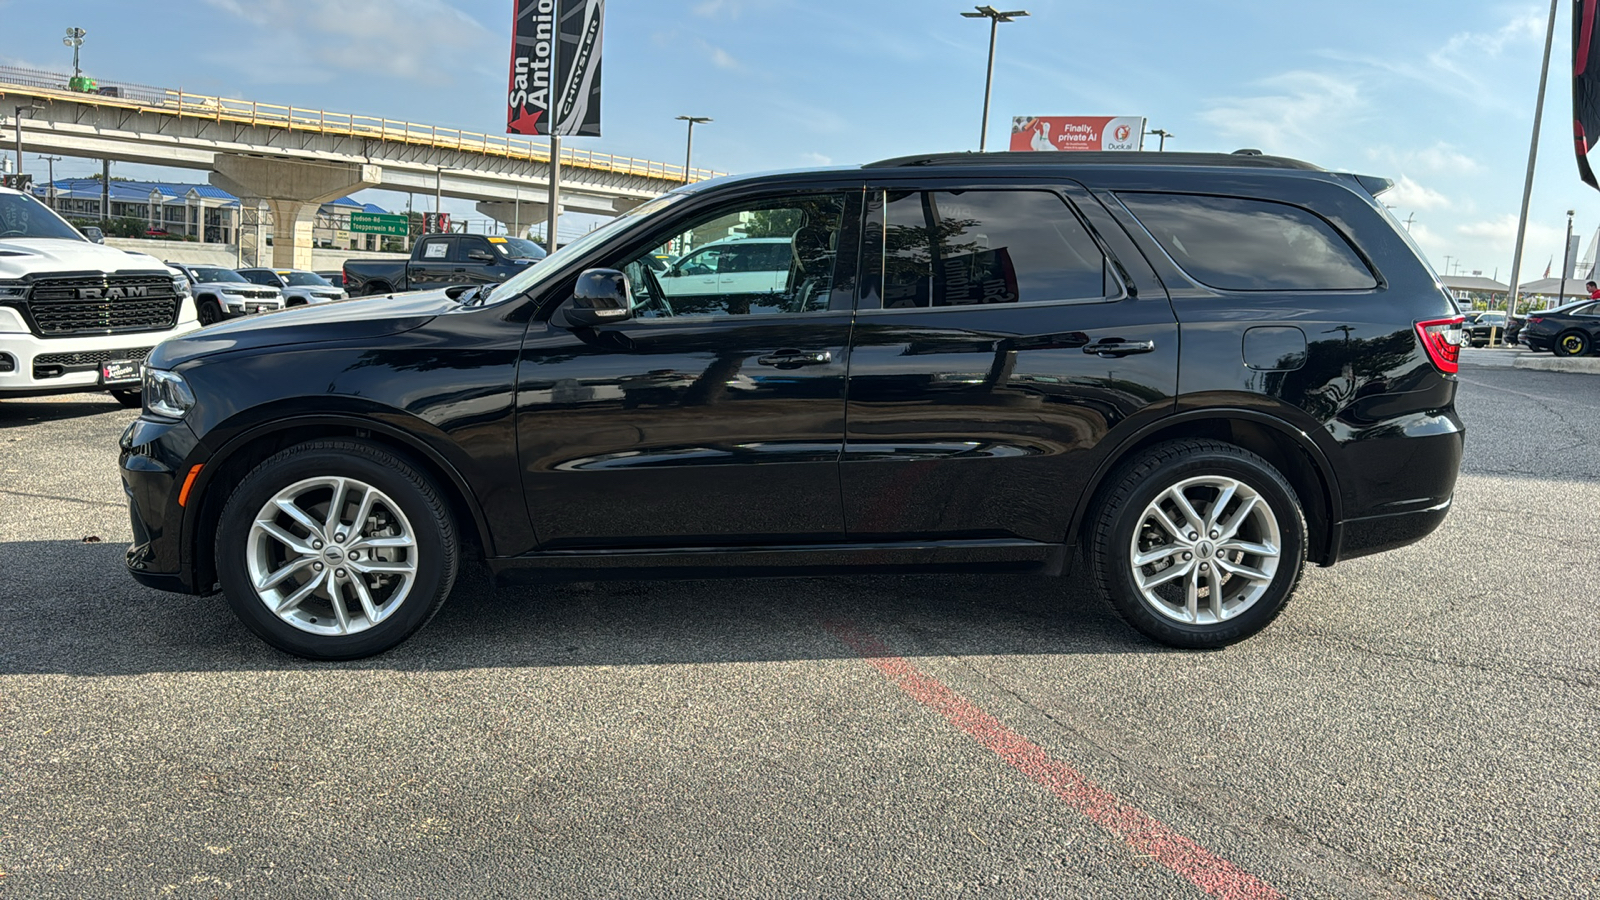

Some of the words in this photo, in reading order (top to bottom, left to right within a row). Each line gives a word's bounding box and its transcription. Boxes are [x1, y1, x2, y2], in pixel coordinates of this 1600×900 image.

[528, 0, 554, 110] Antonio
[563, 19, 598, 115] CHRYSLER
[509, 56, 529, 109] San
[1064, 124, 1093, 134] Finally,
[1058, 133, 1087, 142] private
[1088, 133, 1097, 142] AI
[352, 223, 387, 232] Toepperwein
[78, 286, 148, 299] RAM
